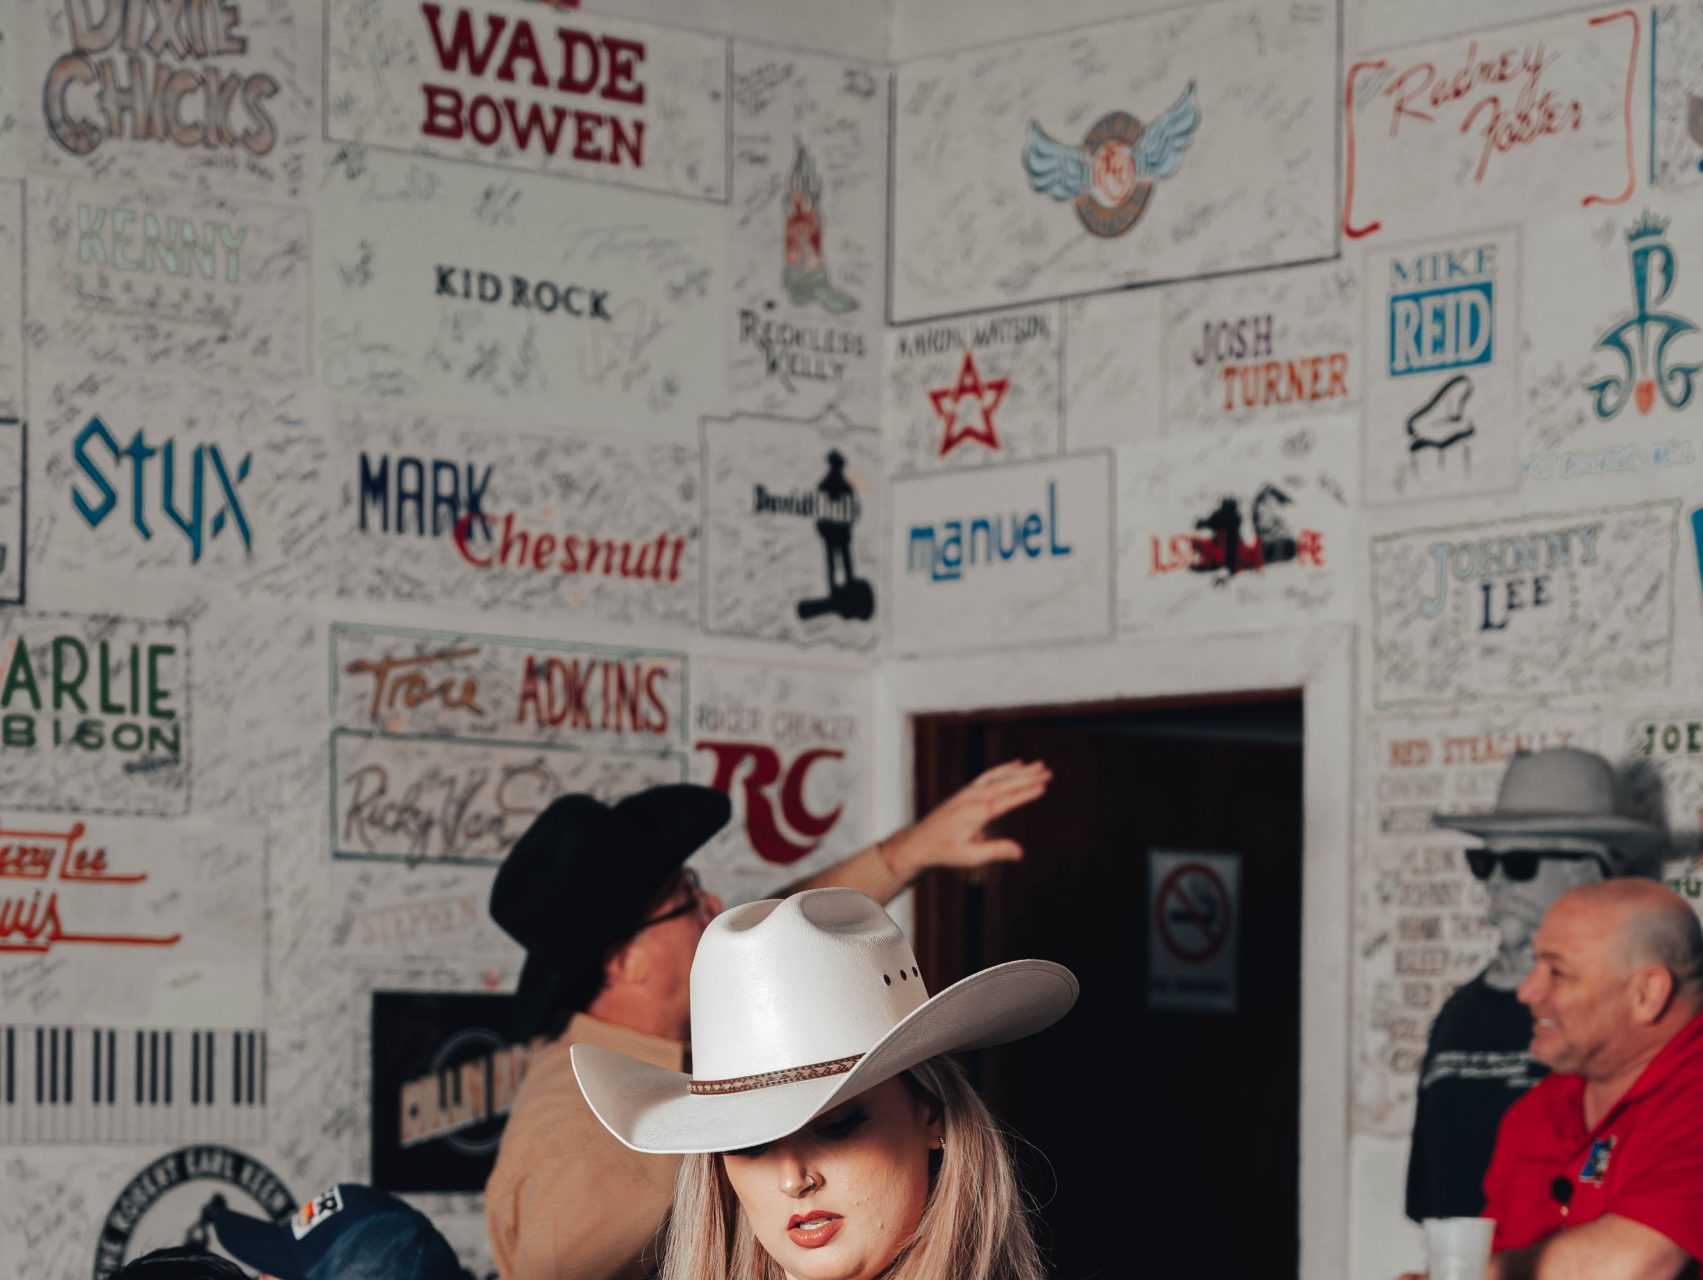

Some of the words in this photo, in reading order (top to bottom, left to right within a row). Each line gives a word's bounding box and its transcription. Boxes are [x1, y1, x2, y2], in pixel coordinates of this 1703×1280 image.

[423, 4, 646, 104] WADE
[43, 51, 280, 155] CHICKS
[421, 84, 646, 168] BOWEN
[80, 204, 246, 284] KENNY
[1391, 244, 1498, 284] MIKE
[435, 265, 499, 300] KID
[512, 276, 612, 321] ROCK
[1393, 288, 1491, 372] REID
[1192, 314, 1274, 366] JOSH
[1222, 353, 1348, 412] TURNER
[358, 451, 494, 542] MARK
[453, 509, 686, 581] Chesnutt
[1419, 522, 1603, 617] JOHNNY
[1481, 576, 1551, 631] LEE
[517, 656, 670, 735] ADKINS
[696, 741, 846, 866] RC
